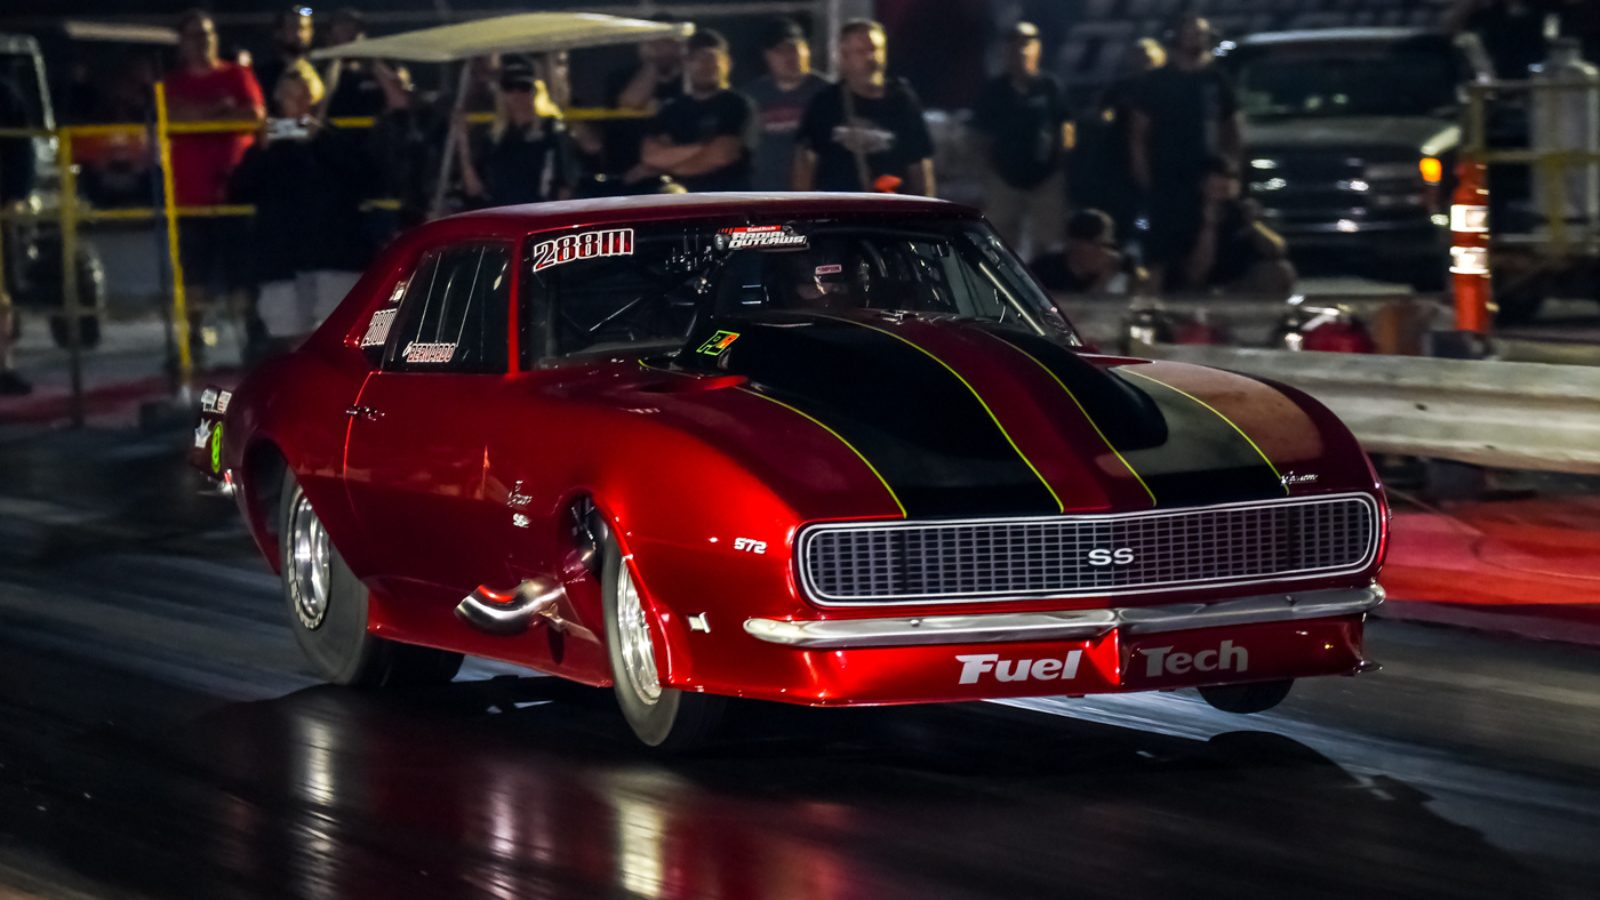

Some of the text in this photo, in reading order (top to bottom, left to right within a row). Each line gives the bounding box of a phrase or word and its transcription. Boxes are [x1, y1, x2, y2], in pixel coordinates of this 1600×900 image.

[728, 236, 807, 249] OUTLAWS
[734, 537, 767, 554] 572
[1088, 548, 1134, 566] SS
[955, 640, 1249, 685] Fuel Tech
